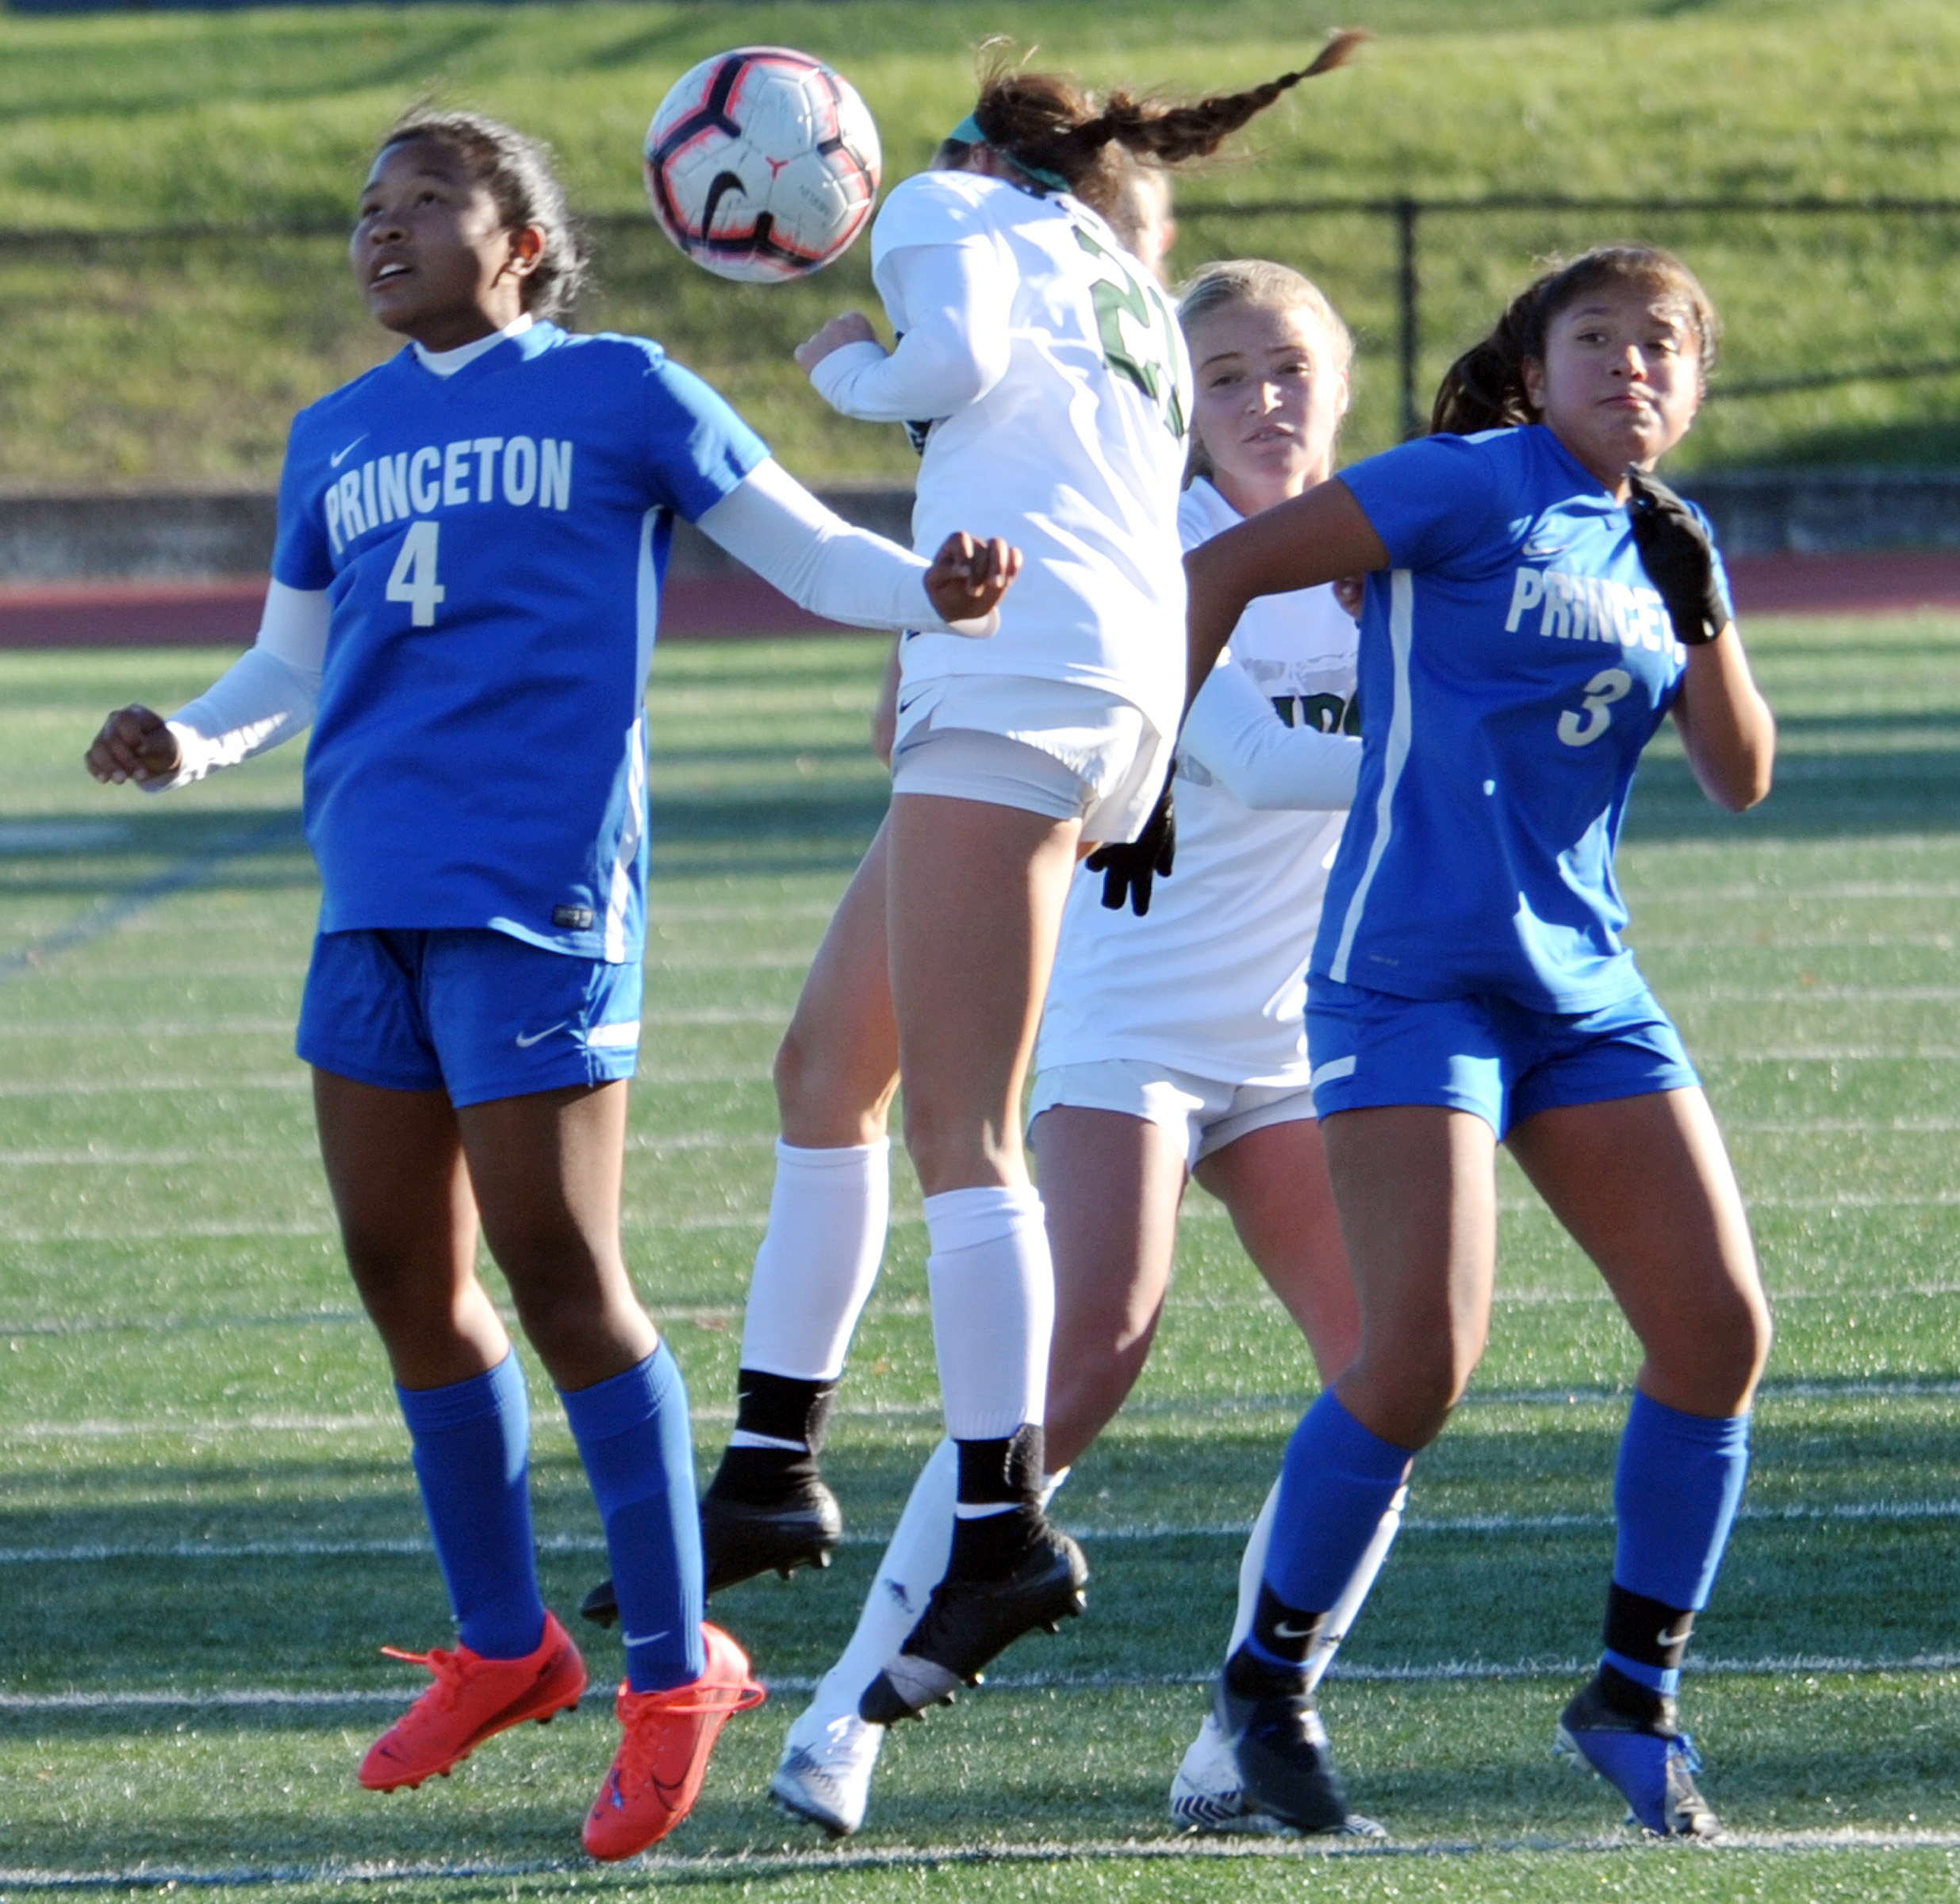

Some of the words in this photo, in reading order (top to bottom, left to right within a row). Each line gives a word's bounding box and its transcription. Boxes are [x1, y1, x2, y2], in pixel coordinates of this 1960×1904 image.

[324, 435, 573, 555] PRINCETON
[385, 520, 445, 627] 4
[1505, 566, 1686, 665] PRINCE
[1557, 668, 1632, 747] 3
